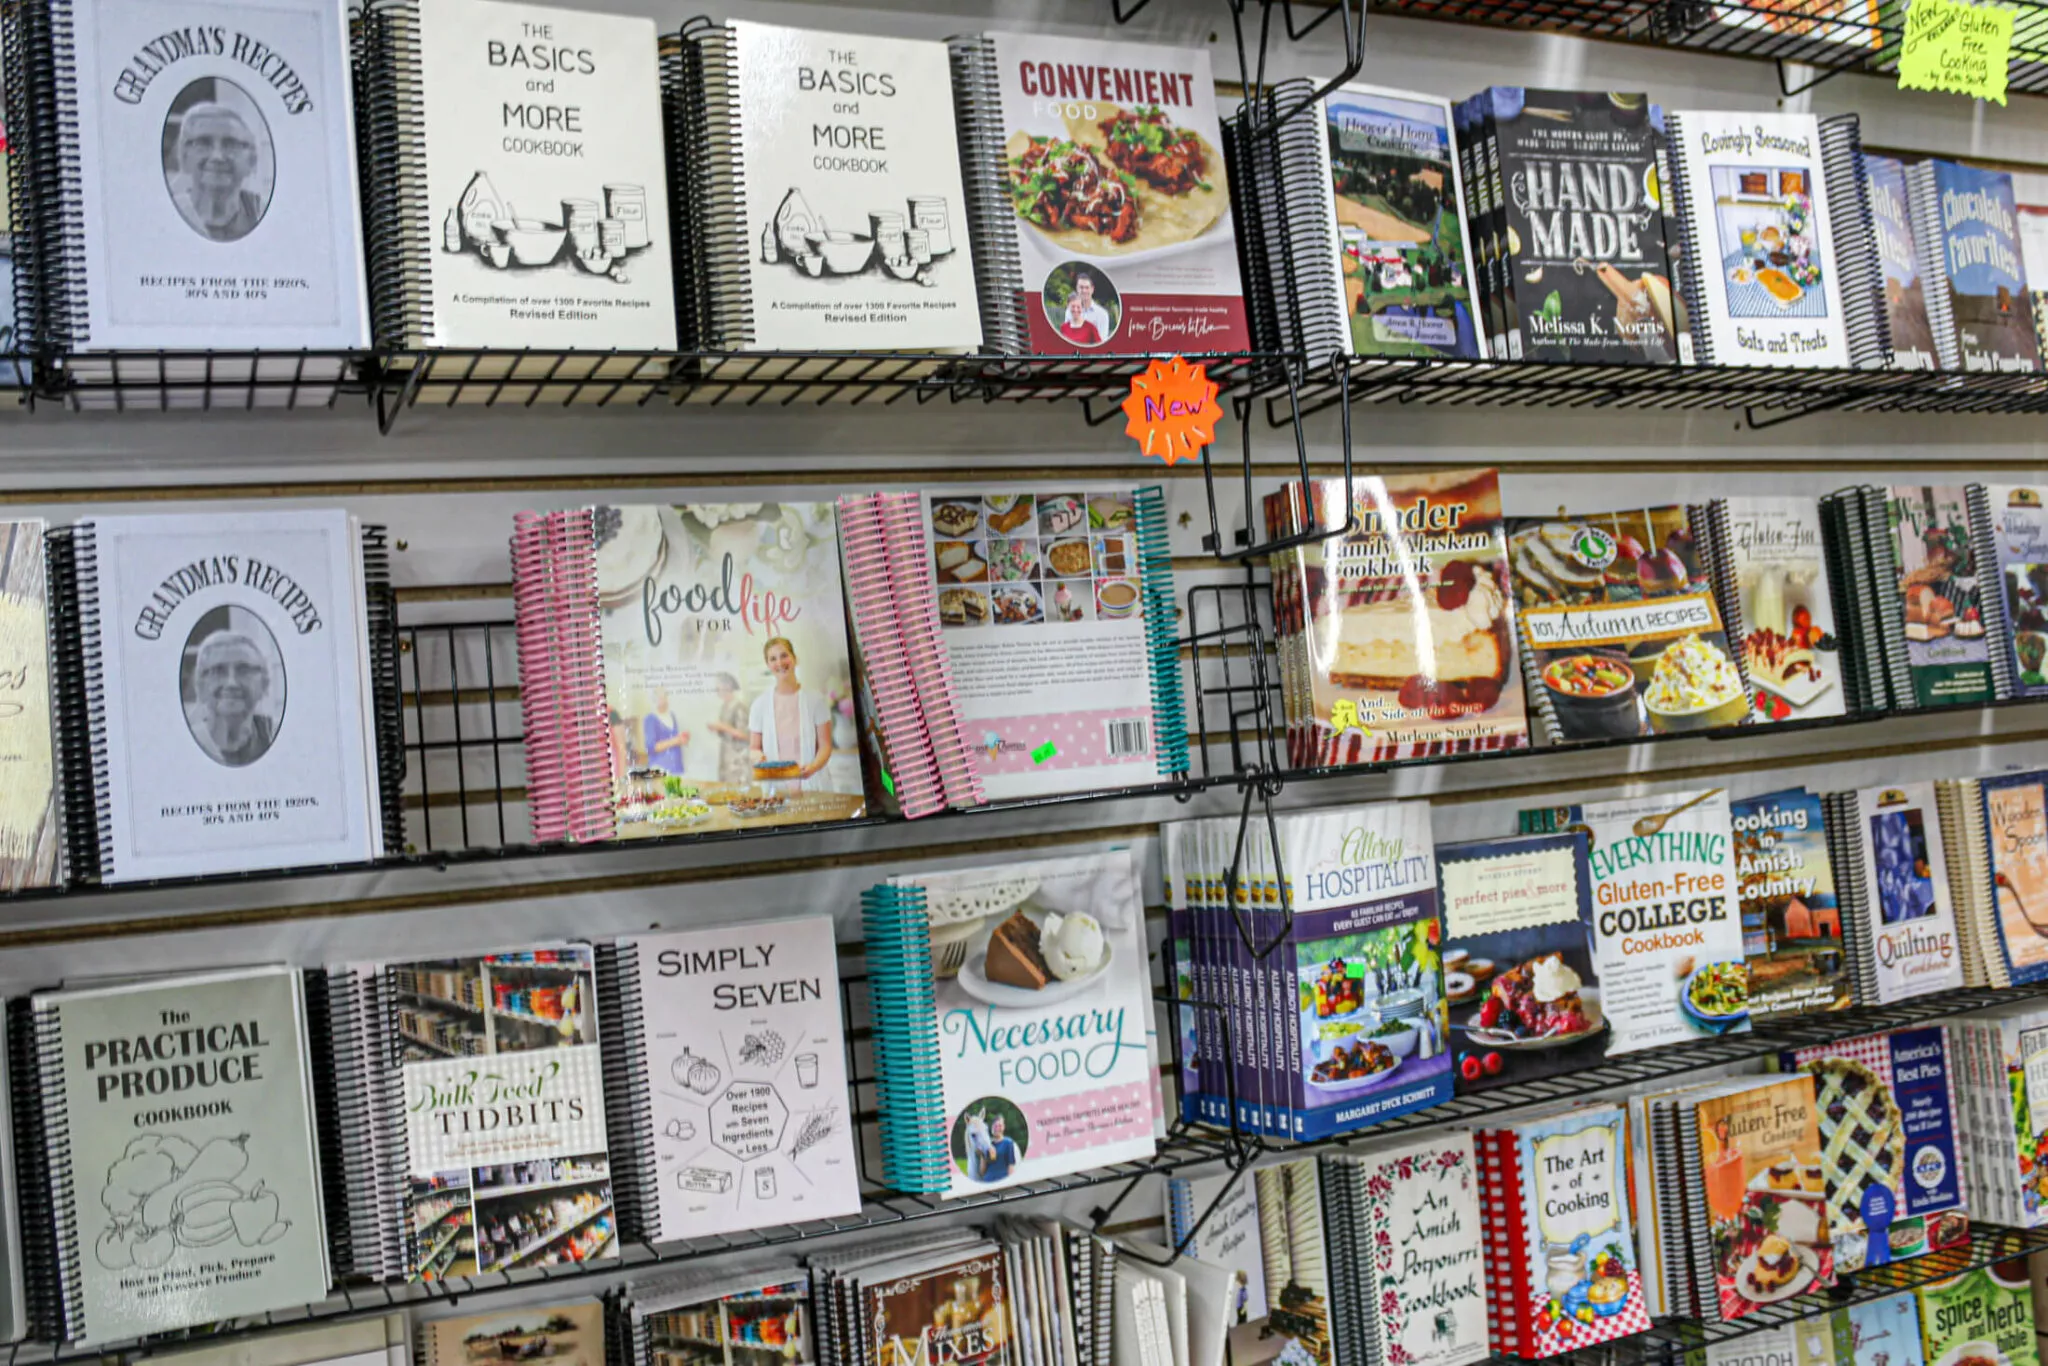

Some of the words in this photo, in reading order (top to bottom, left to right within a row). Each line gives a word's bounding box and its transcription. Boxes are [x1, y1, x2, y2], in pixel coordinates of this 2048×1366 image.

[522, 22, 553, 40] THE
[1960, 10, 1999, 36] Gluten
[487, 40, 596, 75] BASICS
[828, 49, 857, 65] THE
[1962, 36, 1987, 55] Free
[113, 26, 227, 105] GRANDMA'S
[230, 32, 314, 115] RECIPES
[798, 66, 897, 97] BASICS
[1019, 60, 1194, 107] CONVENIENT
[525, 79, 554, 93] and
[503, 102, 582, 133] MORE
[833, 102, 860, 115] and
[1031, 101, 1098, 121] FOOD
[813, 123, 886, 151] MORE
[1400, 123, 1434, 141] Home
[1702, 124, 1752, 156] Lovingly
[1754, 126, 1812, 159] Seasoned
[502, 136, 584, 157] COOKBOOK
[813, 155, 888, 174] COOKBOOK
[1523, 161, 1636, 212] HAND
[1943, 186, 2014, 240] Chocolate
[1529, 211, 1643, 261] MADE
[1947, 229, 2020, 282] Favorites
[140, 275, 196, 287] RECIPES
[200, 277, 238, 287] FROM
[242, 277, 269, 288] THE
[213, 289, 241, 299] AND
[453, 294, 460, 303] A
[462, 294, 517, 305] Compilation
[520, 296, 529, 305] of
[615, 299, 651, 308] Recipes
[510, 308, 555, 320] Revised
[558, 309, 598, 320] Edition
[771, 301, 778, 310] A
[780, 301, 831, 311] Compilation
[833, 302, 842, 310] of
[923, 302, 957, 311] Recipes
[824, 313, 867, 323] Revised
[869, 313, 907, 323] Edition
[1529, 315, 1586, 335] Melissa
[1590, 313, 1609, 335] K.
[1613, 317, 1665, 335] Norris
[1767, 333, 1787, 353] and
[1790, 328, 1828, 350] Treats
[134, 555, 238, 641] GRANDMA'S
[243, 557, 323, 635] RECIPES
[643, 552, 742, 647] food
[740, 573, 802, 637] life
[696, 618, 732, 632] FOR
[1557, 612, 1647, 641] Autumn
[1647, 607, 1708, 626] RECIPES
[1359, 711, 1376, 724] My
[1383, 710, 1406, 720] Side
[1411, 709, 1423, 718] of
[1386, 726, 1440, 744] Marlene
[1445, 723, 1498, 738] Snader
[161, 803, 213, 818] RECIPES
[216, 801, 252, 813] FROM
[255, 800, 281, 810] THE
[228, 813, 255, 824] AND
[1339, 826, 1404, 867] Allergy
[1759, 832, 1776, 848] in
[1588, 832, 1725, 881] EVERYTHING
[1739, 852, 1804, 876] Amish
[1306, 854, 1430, 902] HOSPITALITY
[1597, 873, 1725, 906] Gluten-Free
[1454, 890, 1498, 909] perfect
[1502, 888, 1527, 903] pies
[1536, 882, 1567, 895] more
[1333, 921, 1353, 932] EVERY
[1353, 918, 1371, 928] GUEST
[1372, 915, 1384, 924] CAN
[1599, 896, 1727, 937] COLLEGE
[1621, 928, 1704, 956] Cookbook
[1877, 927, 1953, 970] Quilting
[657, 944, 775, 978] SIMPLY
[713, 978, 822, 1012] SEVEN
[159, 1009, 190, 1026] The
[85, 1021, 270, 1070] PRACTICAL
[943, 1004, 1128, 1079] Necessary
[1894, 1041, 1941, 1064] America's
[97, 1053, 263, 1102] PRODUCE
[999, 1048, 1082, 1087] FOOD
[1896, 1067, 1919, 1083] Best
[1920, 1064, 1942, 1078] Pies
[726, 1090, 748, 1101] Over
[1336, 1103, 1381, 1124] MARGARET
[1381, 1095, 1402, 1111] DYCK
[1402, 1086, 1436, 1105] SCHMITT
[134, 1100, 233, 1128] COOKBOOK
[434, 1097, 584, 1136] TIDBITS
[732, 1102, 768, 1116] Recipes
[740, 1115, 769, 1126] Seven
[722, 1129, 774, 1143] Ingredients
[1716, 1103, 1808, 1146] Gluten-Free
[746, 1143, 768, 1153] Less
[1543, 1154, 1574, 1174] The
[1579, 1148, 1605, 1167] Art
[1569, 1172, 1583, 1190] of
[1412, 1189, 1449, 1216] An
[1545, 1191, 1610, 1218] Cooking
[1401, 1210, 1461, 1246] Amish
[231, 1253, 275, 1269] Prepare
[1398, 1241, 1479, 1284] Potpourri
[215, 1268, 262, 1284] Produce
[1936, 1295, 1983, 1336] spice
[1967, 1318, 1985, 1341] and
[1986, 1293, 2026, 1334] herb
[889, 1324, 995, 1366] MIXES
[1996, 1328, 2028, 1354] bible
